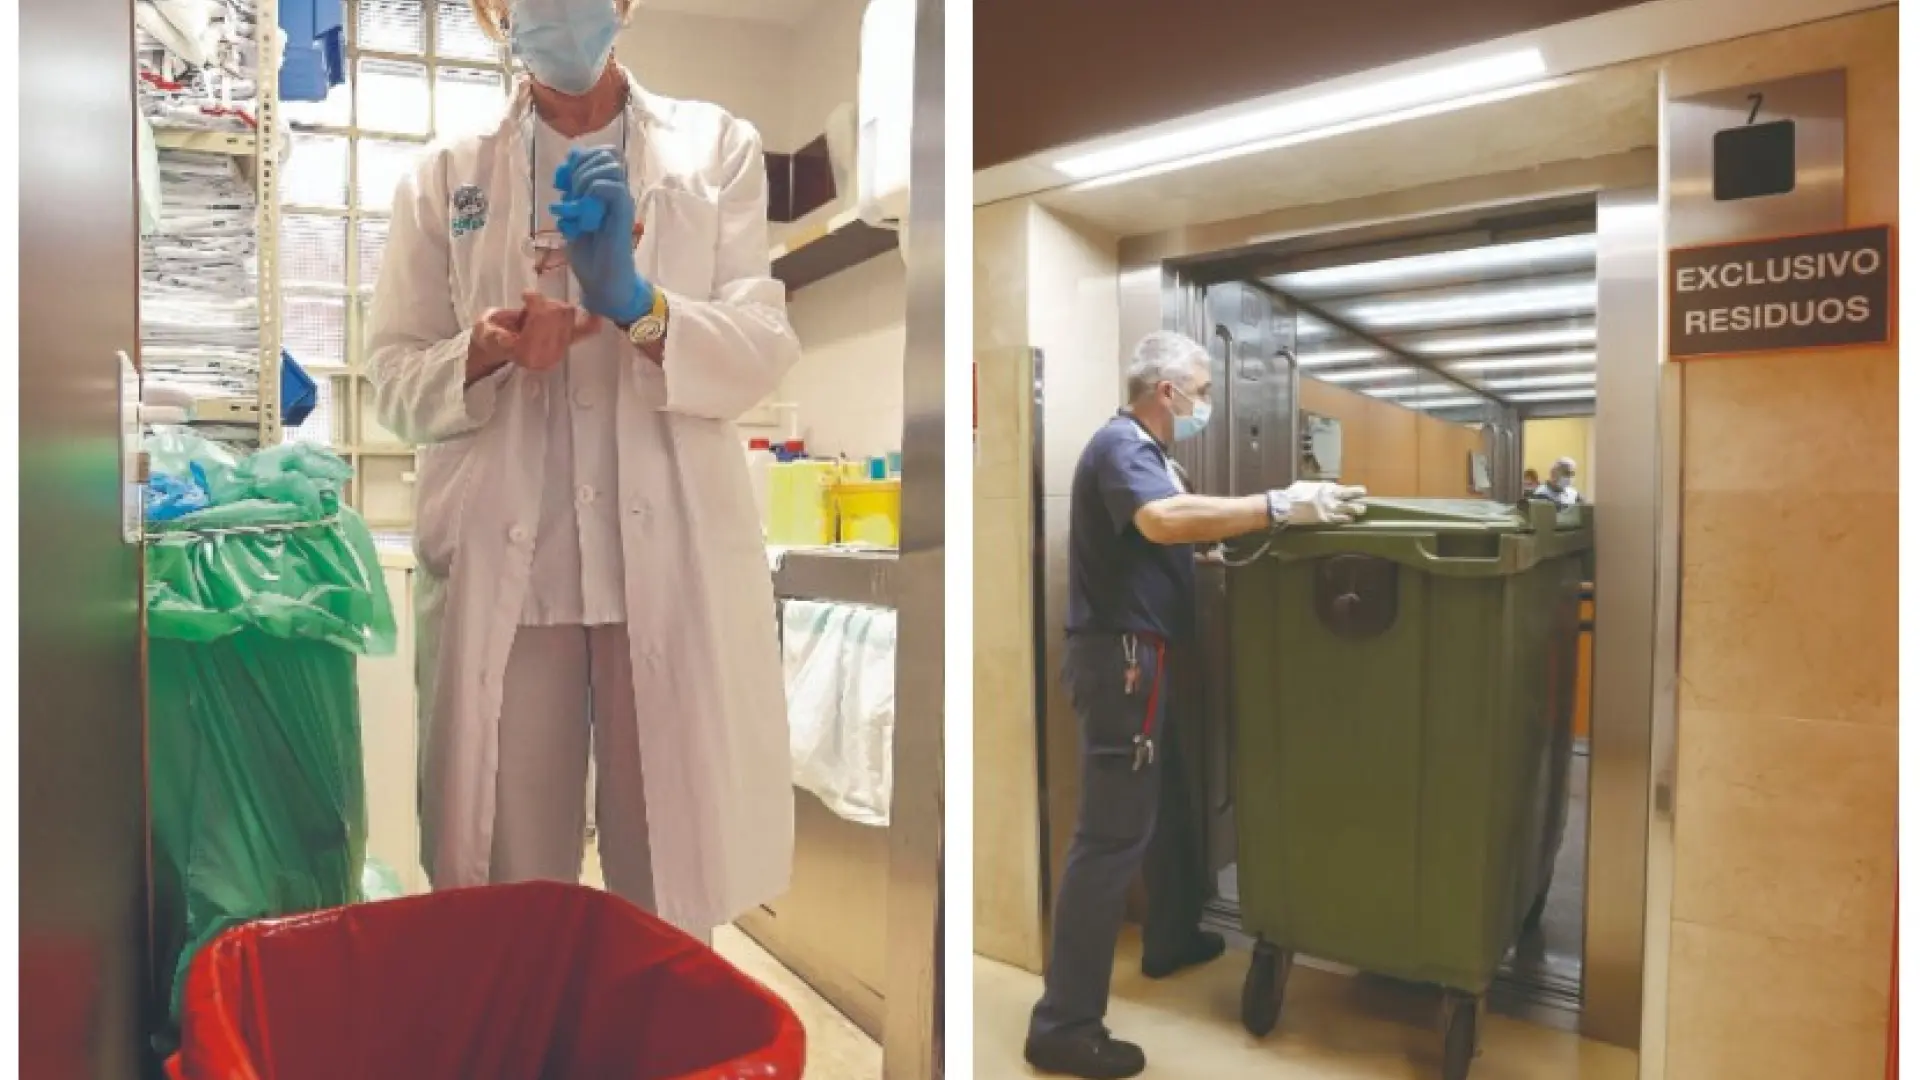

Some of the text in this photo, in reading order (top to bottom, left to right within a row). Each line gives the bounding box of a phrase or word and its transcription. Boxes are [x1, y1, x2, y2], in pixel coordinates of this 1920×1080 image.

[1747, 92, 1763, 125] 7
[1676, 249, 1880, 292] EXCLUSIVO
[1685, 295, 1870, 335] RESIDUOS
